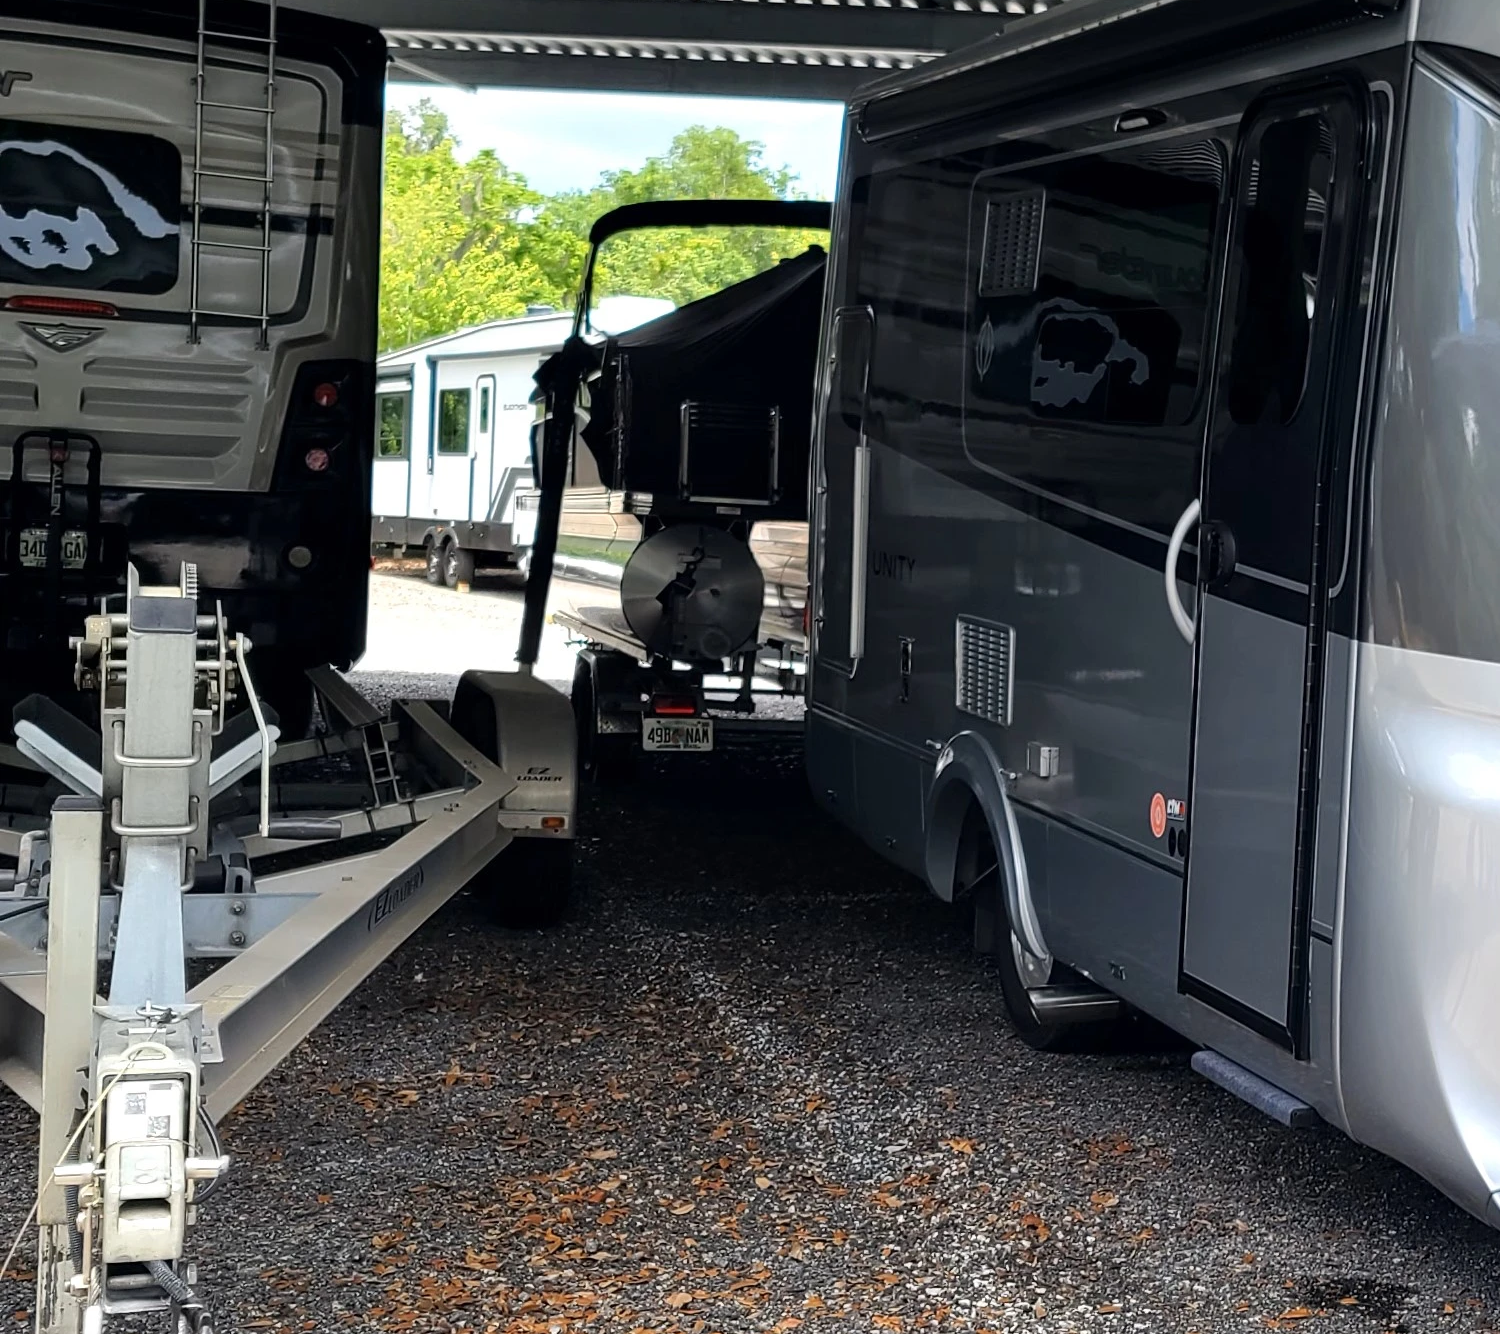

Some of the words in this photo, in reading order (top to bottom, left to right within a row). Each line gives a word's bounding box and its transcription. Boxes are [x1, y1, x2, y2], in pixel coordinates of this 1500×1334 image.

[51, 465, 63, 516] ALLEN
[872, 550, 917, 583] UNITY
[516, 774, 563, 782] LOADER
